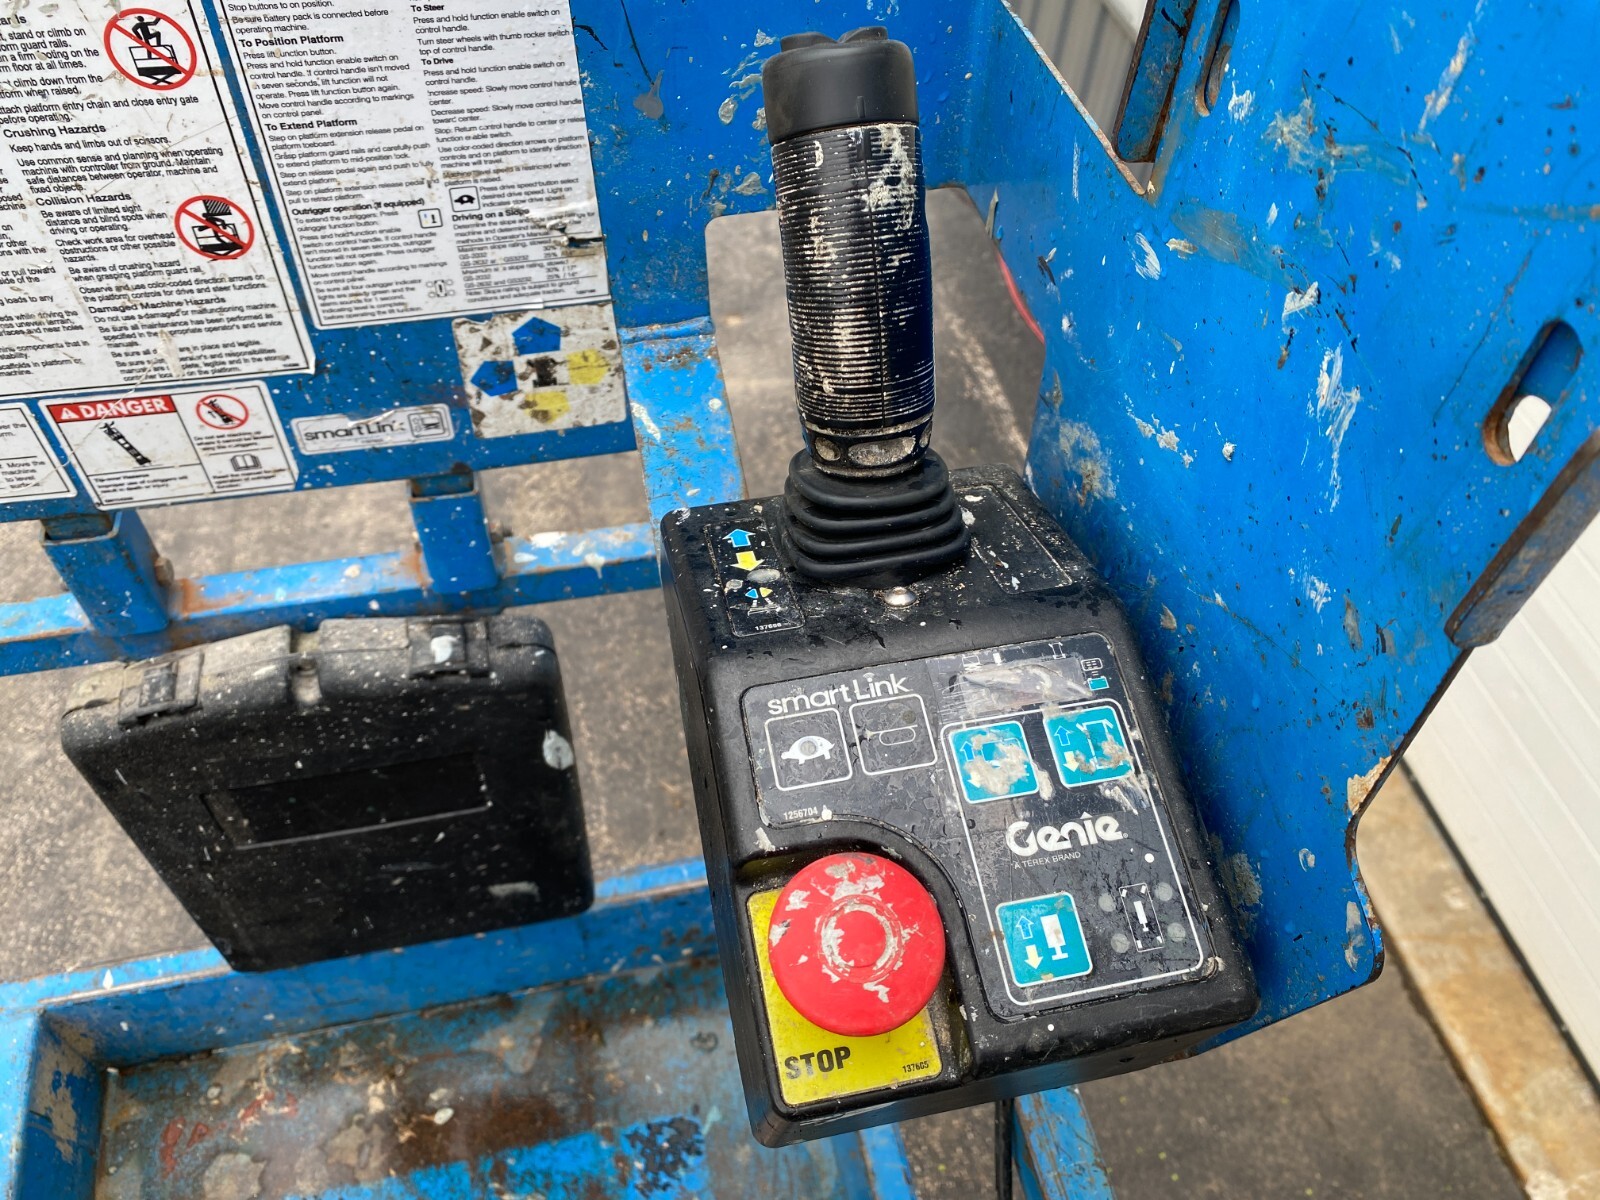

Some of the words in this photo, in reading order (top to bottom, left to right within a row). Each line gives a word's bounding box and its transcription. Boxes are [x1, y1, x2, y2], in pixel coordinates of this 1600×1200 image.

[228, 3, 247, 12] Stop
[248, 3, 279, 11] buttons
[301, 0, 334, 9] position.
[243, 16, 262, 24] sure
[262, 14, 291, 23] battery
[292, 13, 313, 22] pack
[321, 10, 363, 19] connected
[363, 9, 389, 17] before
[436, 15, 451, 23] and
[452, 14, 469, 22] hold
[470, 13, 499, 21] function
[500, 11, 526, 19] enable
[527, 9, 549, 17] switch
[8, 30, 34, 40] stand
[47, 28, 72, 38] climb
[235, 26, 273, 35] operating
[273, 24, 309, 32] machine.
[415, 25, 441, 34] control
[442, 24, 469, 32] handle.
[239, 39, 253, 47] To
[254, 37, 298, 47] Position
[299, 35, 344, 44] Platform
[455, 35, 482, 43] wheels
[547, 29, 570, 37] switch
[20, 39, 48, 52] guard
[48, 39, 72, 48] rails.
[441, 45, 467, 54] control
[468, 44, 494, 52] handle.
[17, 51, 37, 61] firm
[70, 50, 83, 58] on
[83, 48, 100, 57] the
[276, 48, 309, 58] unction
[309, 48, 336, 56] button.
[12, 62, 33, 72] floor
[35, 62, 45, 71] at
[46, 60, 57, 70] all
[58, 59, 87, 69] times.
[336, 57, 362, 65] enable
[363, 55, 387, 63] switch
[433, 57, 454, 65] Drive
[13, 77, 38, 87] climb
[39, 77, 65, 85] down
[65, 75, 87, 84] from
[87, 74, 103, 83] the
[24, 88, 50, 97] when
[50, 85, 82, 95] raised.
[23, 103, 61, 115] platform
[62, 101, 84, 112] entry
[86, 99, 111, 109] chain
[112, 98, 130, 108] and
[131, 98, 155, 107] close
[156, 96, 177, 106] entry
[179, 95, 199, 106] gate
[27, 111, 73, 124] operating.
[3, 127, 57, 138] Crushing
[57, 124, 106, 135] Hazards
[265, 123, 278, 131] To
[279, 121, 314, 130] Extend
[316, 119, 358, 128] Platform
[9, 144, 34, 153] Keep
[33, 141, 63, 151] hands
[64, 140, 82, 150] and
[81, 139, 106, 148] limbs
[107, 138, 123, 147] out
[123, 137, 132, 146] of
[133, 136, 171, 146] scissors.
[16, 158, 36, 167] Use
[37, 157, 75, 166] common
[104, 153, 121, 162] and
[122, 151, 159, 163] planning
[159, 150, 184, 160] when
[184, 147, 224, 160] operating
[21, 167, 59, 176] machine
[59, 165, 79, 173] with
[79, 162, 119, 172] controller
[140, 159, 175, 170] ground.
[174, 156, 211, 166] Maintain
[26, 176, 45, 185] safe
[46, 175, 88, 184] distances
[88, 172, 125, 181] between
[125, 169, 164, 180] operator,
[165, 167, 201, 176] machine
[202, 165, 218, 174] and
[29, 185, 52, 194] fixed
[51, 182, 86, 194] objects.
[35, 196, 84, 206] Collision
[85, 193, 132, 203] Hazards
[40, 210, 54, 218] Be
[82, 207, 92, 215] of
[92, 206, 121, 214] limited
[121, 204, 143, 214] sight
[78, 398, 169, 418] DANGER
[783, 806, 818, 820] 1256704
[1005, 811, 1124, 857] Genie
[1014, 862, 1021, 870] A
[1023, 857, 1052, 868] TEREX
[1052, 851, 1081, 863] BRAND
[784, 1046, 851, 1080] STOP
